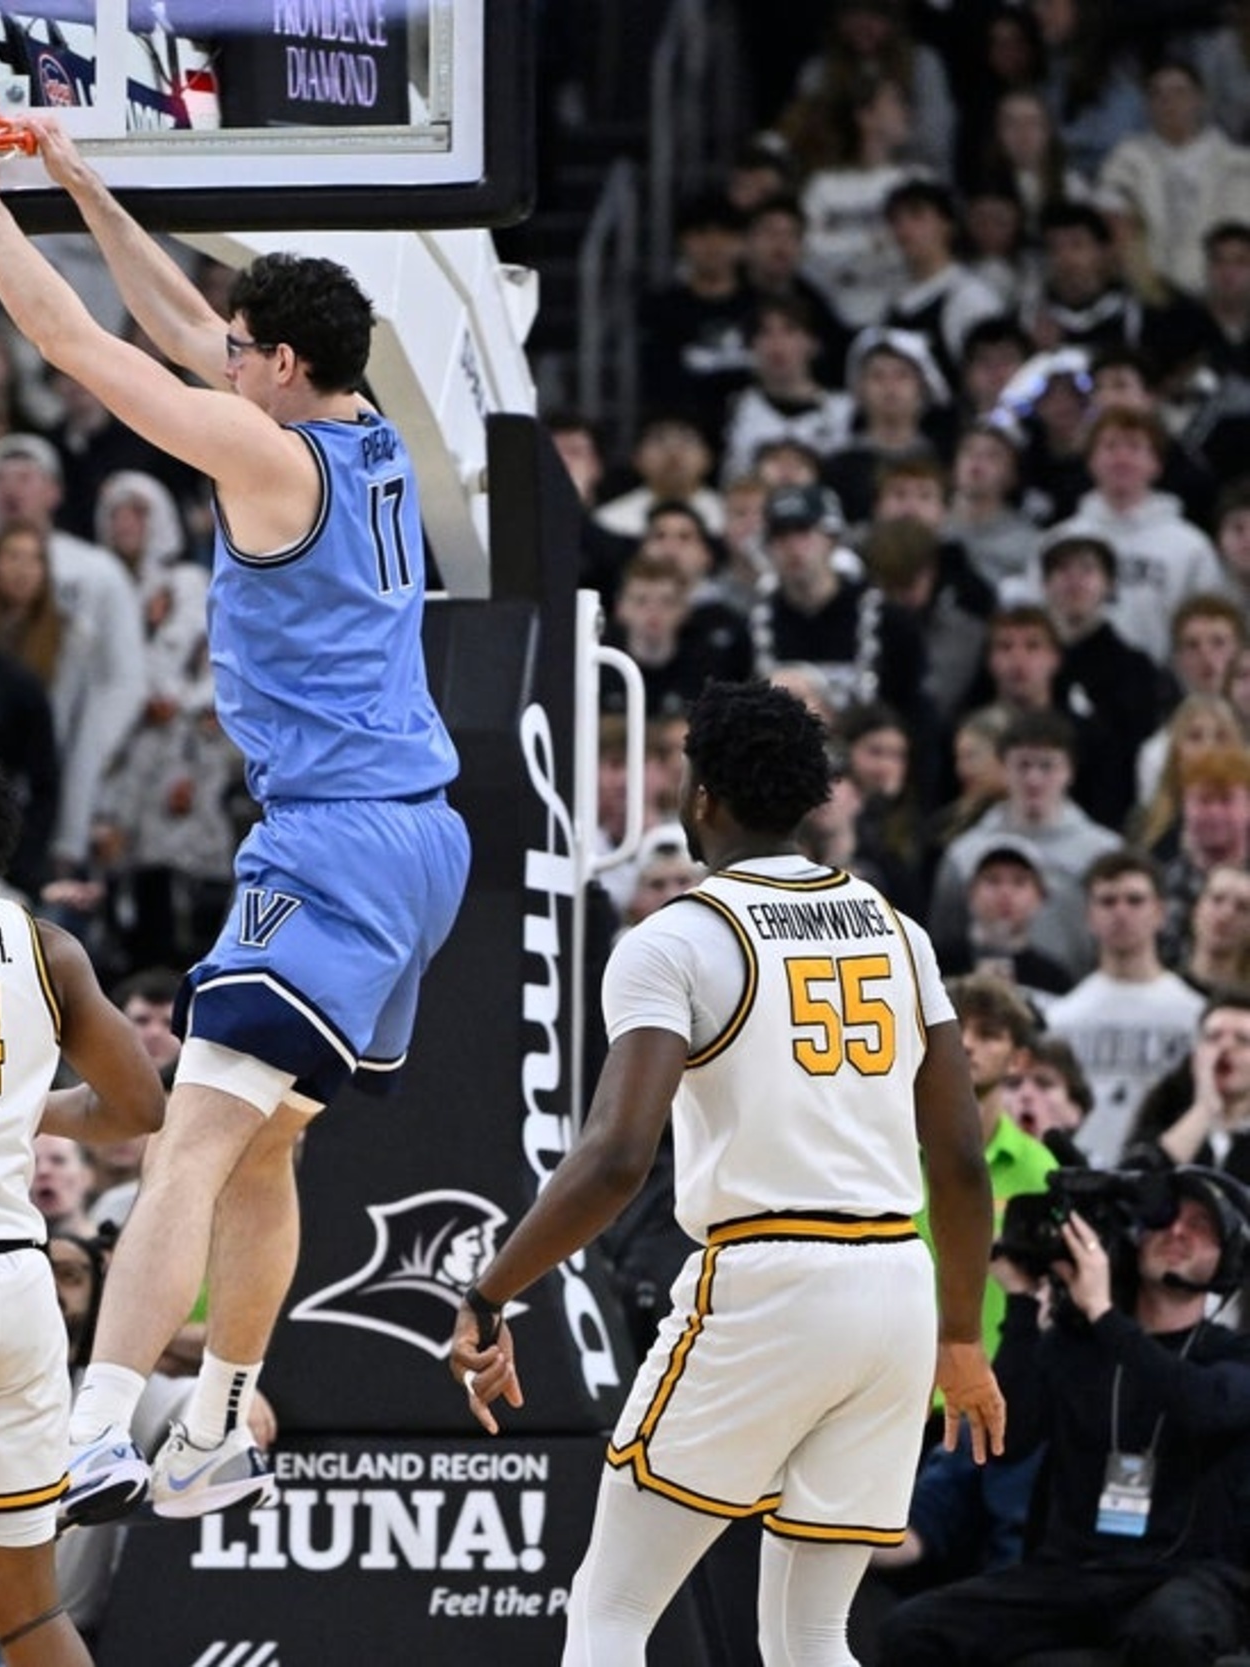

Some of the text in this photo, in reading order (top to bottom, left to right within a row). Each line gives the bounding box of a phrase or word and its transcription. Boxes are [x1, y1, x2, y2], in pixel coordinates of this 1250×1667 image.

[286, 46, 378, 107] DIAMOND
[367, 475, 413, 596] 17
[520, 702, 620, 1401] Amia
[783, 953, 896, 1077] 55
[275, 1452, 548, 1481] ENGLAND REGION
[190, 1489, 546, 1572] LiUNA!
[429, 1586, 490, 1616] Feel
[494, 1588, 542, 1616] the
